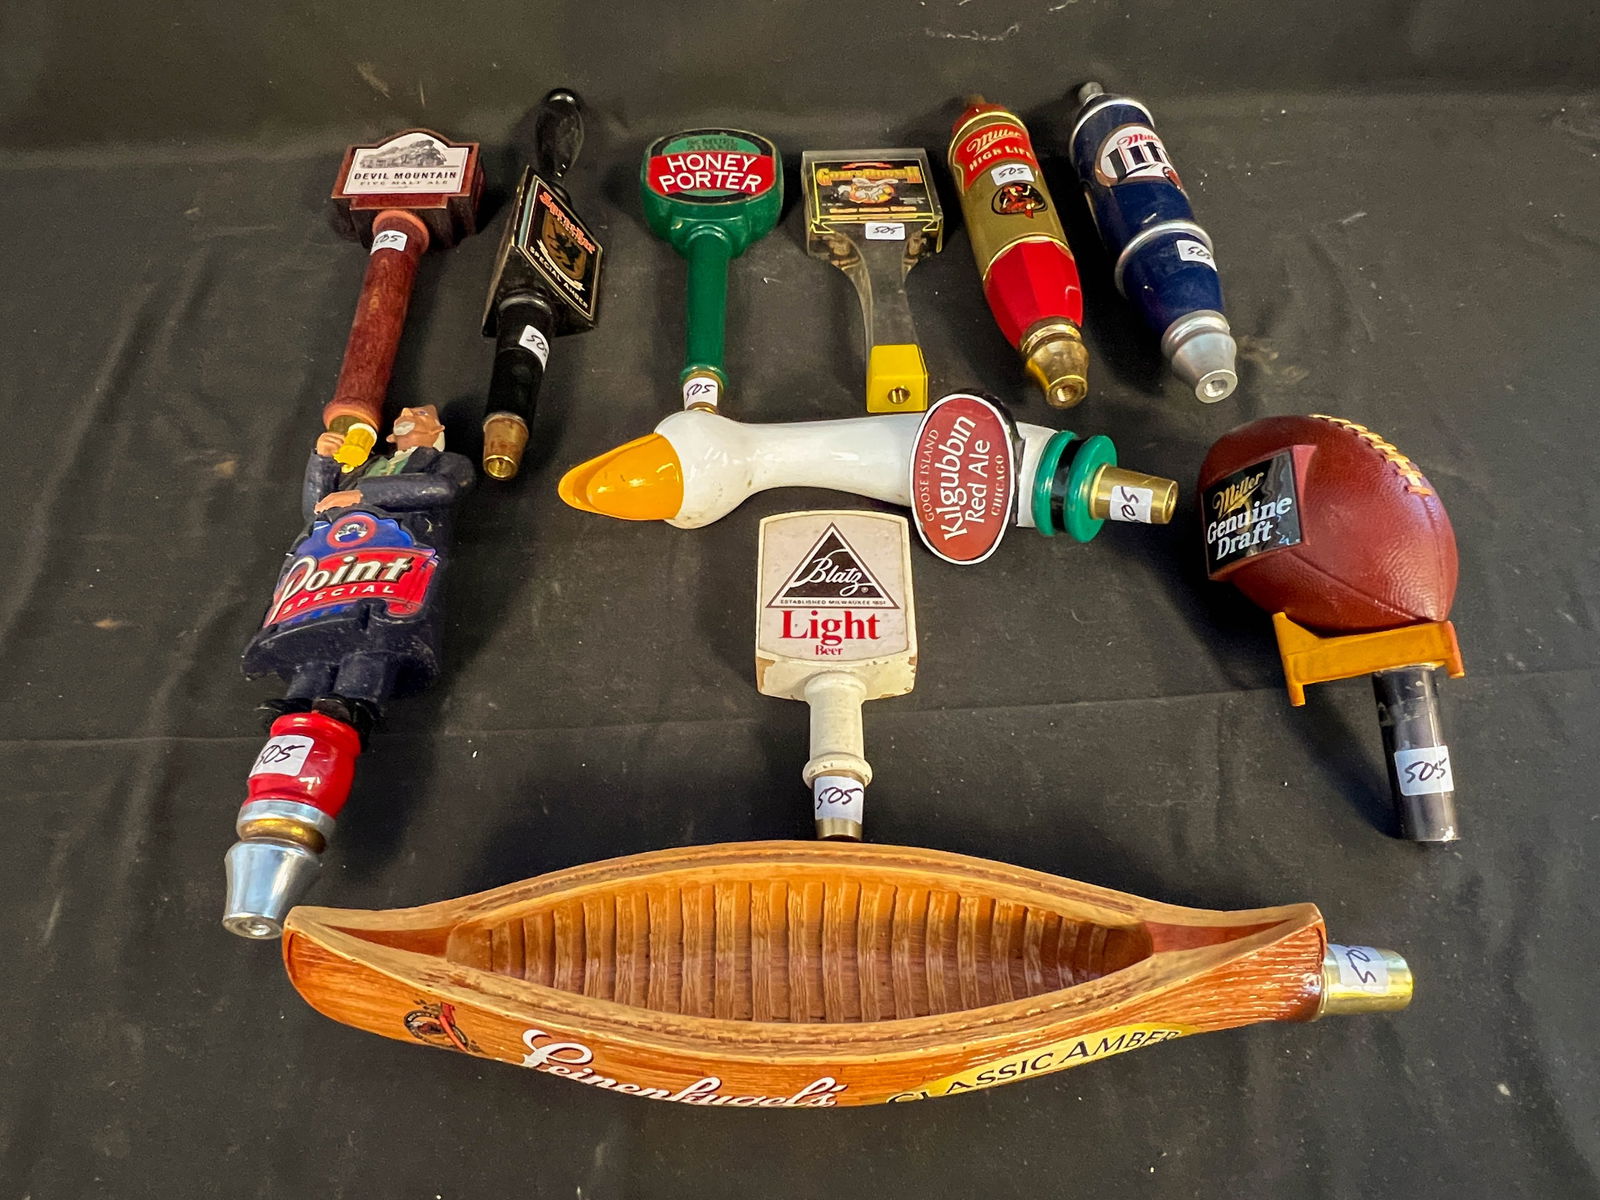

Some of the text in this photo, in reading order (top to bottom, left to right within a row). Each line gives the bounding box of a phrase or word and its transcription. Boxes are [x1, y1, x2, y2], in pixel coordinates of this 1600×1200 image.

[966, 128, 1023, 156] Miller
[353, 171, 457, 180] DEVIL MOUNTAIN
[666, 153, 758, 173] HONEY
[969, 148, 1002, 171] HIGH
[998, 167, 1028, 178] 505
[658, 171, 762, 192] PORTER
[873, 225, 903, 235] 505
[529, 245, 589, 310] SPECIAL AMBER
[919, 428, 940, 523] GOOSE ISLAND
[934, 415, 977, 541] Kilgubbin
[964, 438, 991, 524] Red Ale
[990, 454, 1005, 517] CHICAGO
[1212, 472, 1265, 519] Miller
[1206, 495, 1293, 545] Genuine
[1215, 521, 1274, 561] Draft
[263, 554, 415, 627] Point
[803, 553, 868, 597] Blatz
[281, 584, 396, 616] SPECIAL
[778, 610, 881, 646] Light
[815, 645, 844, 656] Beer
[1404, 757, 1447, 784] 505
[817, 787, 864, 810] 505
